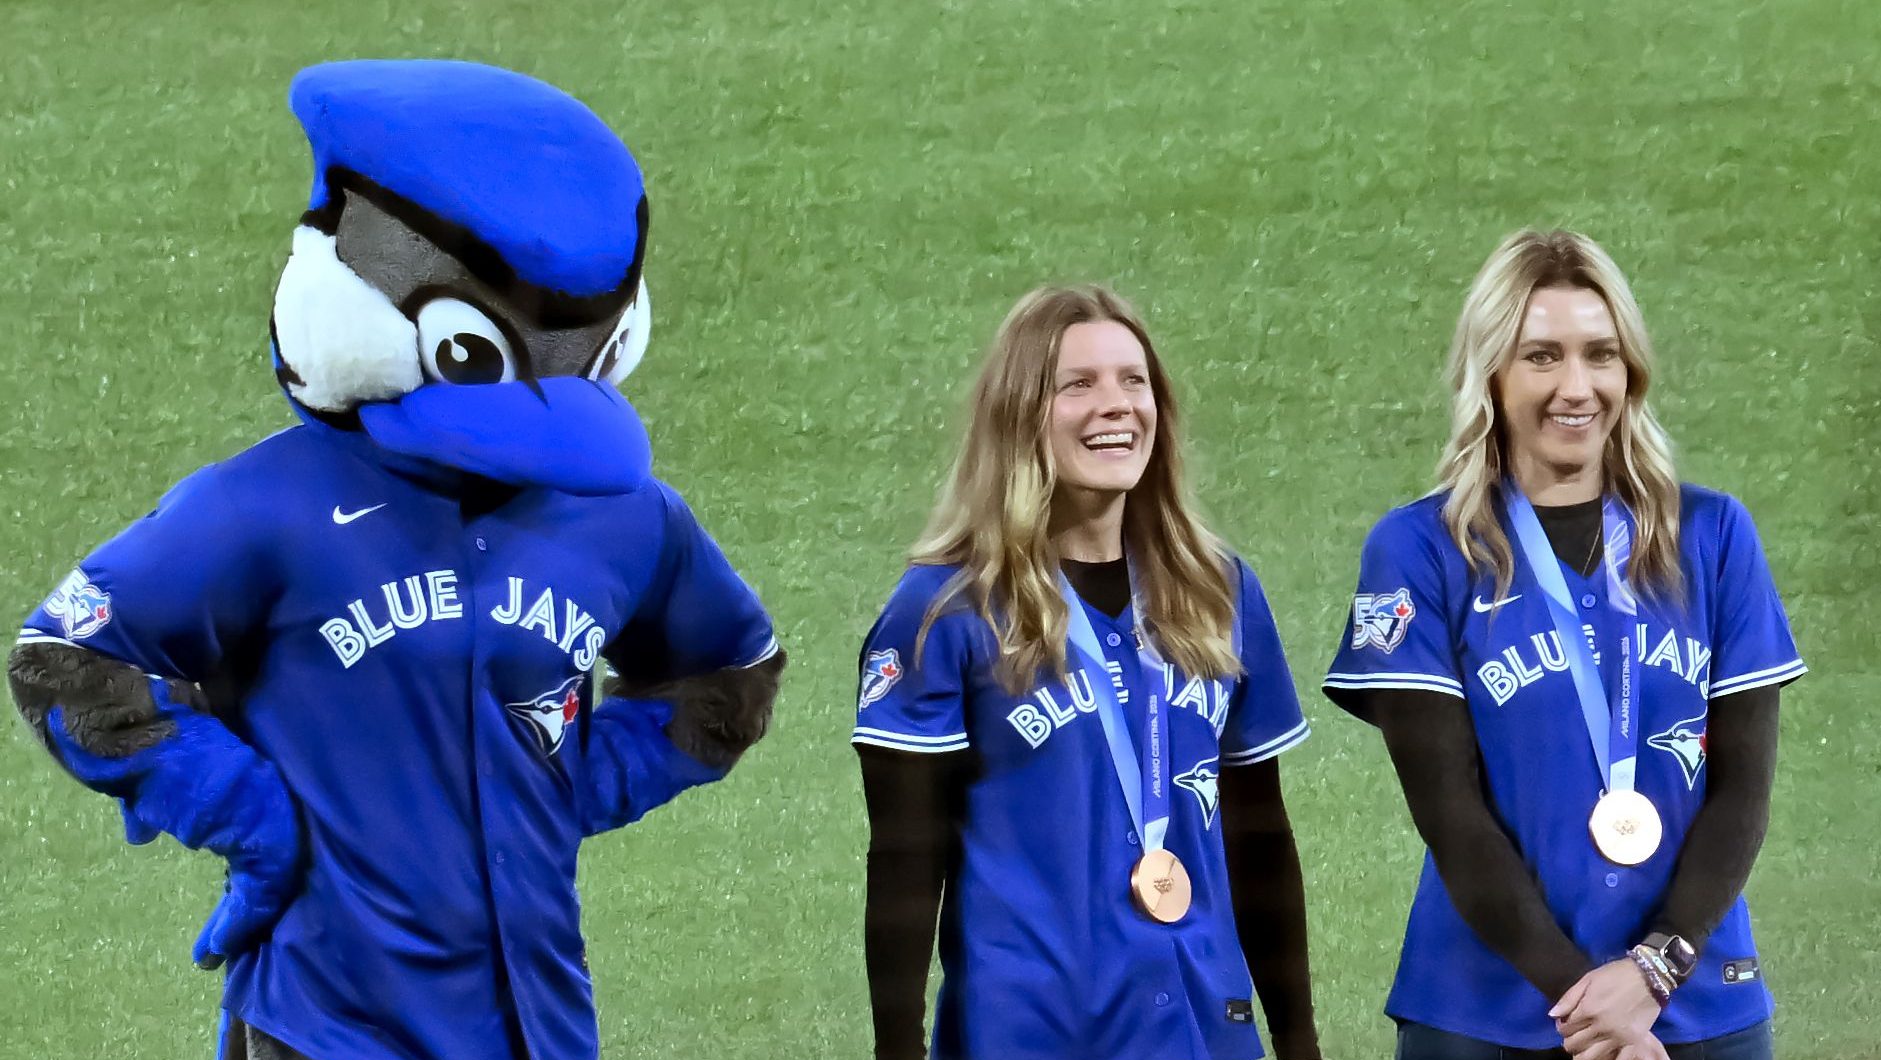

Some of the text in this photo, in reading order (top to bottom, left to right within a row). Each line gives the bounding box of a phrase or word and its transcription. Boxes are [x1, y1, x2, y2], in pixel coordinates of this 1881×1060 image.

[319, 569, 606, 672] BLUE JAYS
[1162, 662, 1230, 740] JAY
